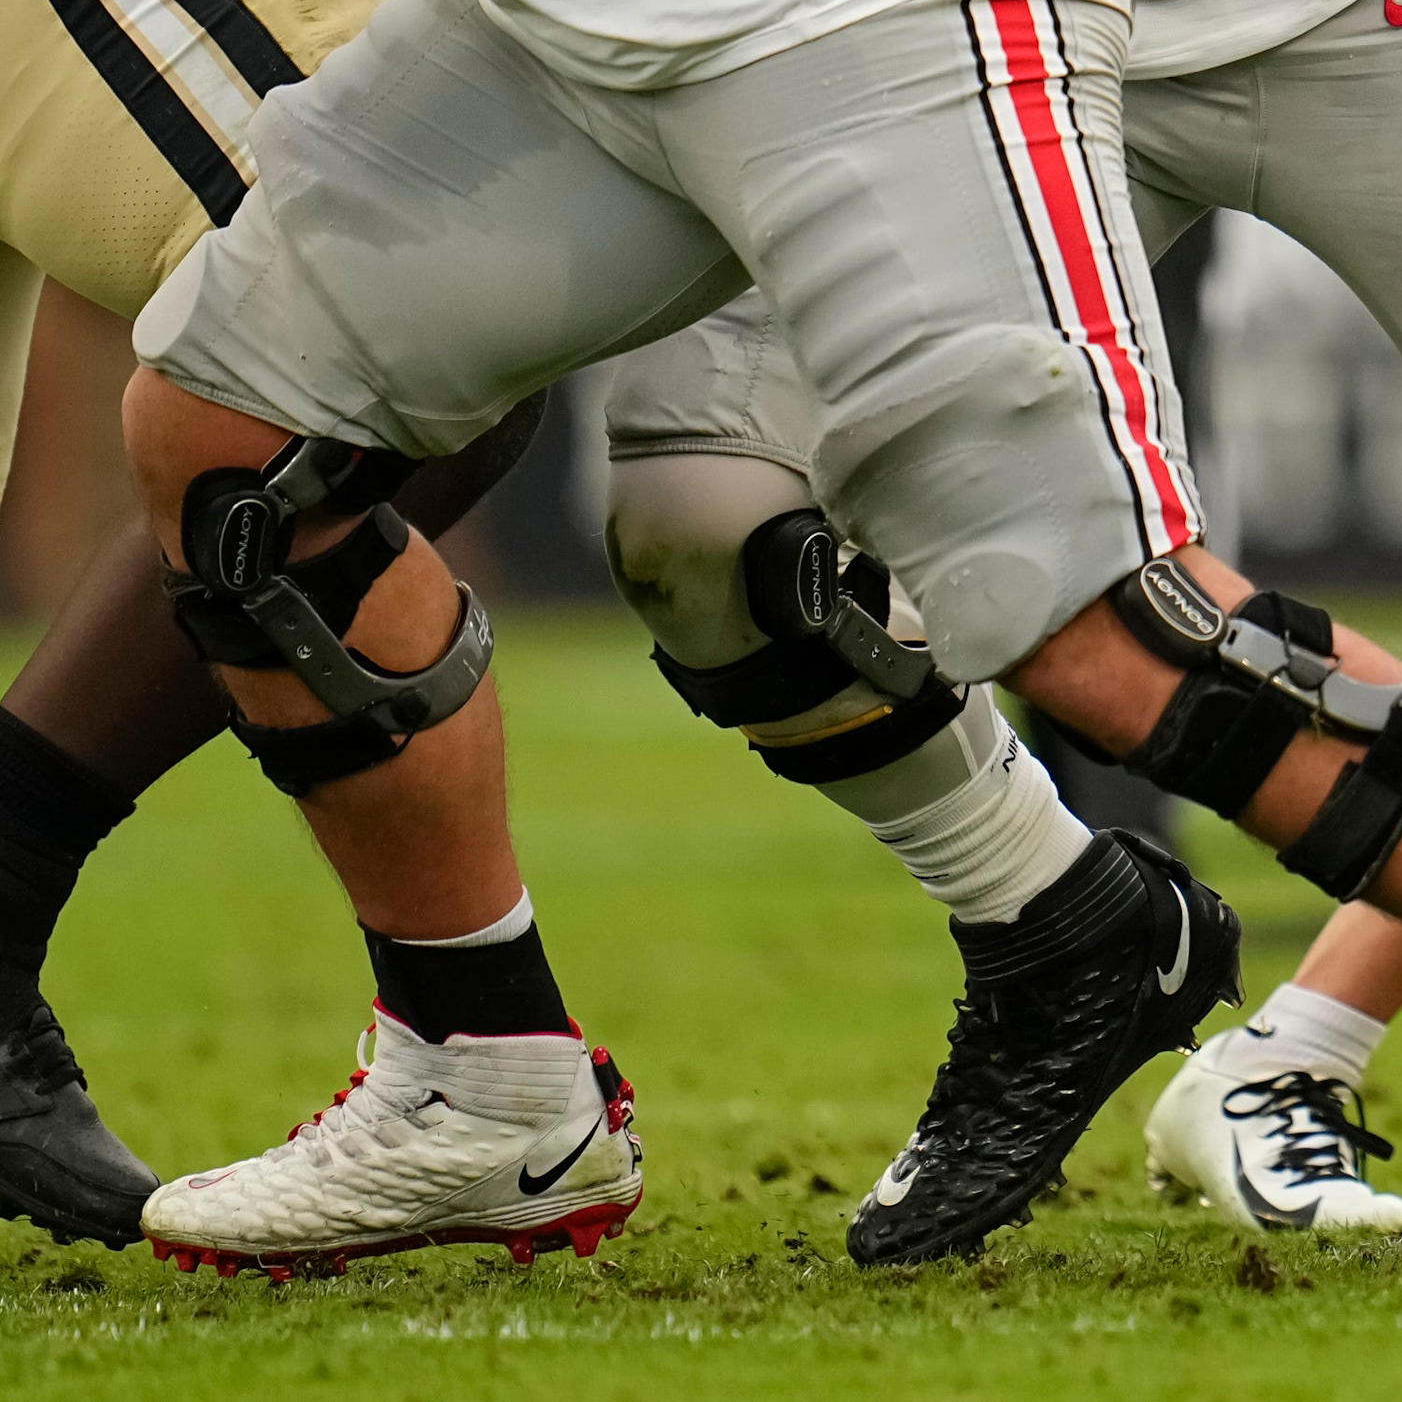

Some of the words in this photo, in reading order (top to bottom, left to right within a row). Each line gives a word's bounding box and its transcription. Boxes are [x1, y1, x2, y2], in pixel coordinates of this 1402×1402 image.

[233, 506, 253, 586] DONJOY
[812, 540, 823, 620] DONJOY
[1146, 571, 1215, 634] DONJOY
